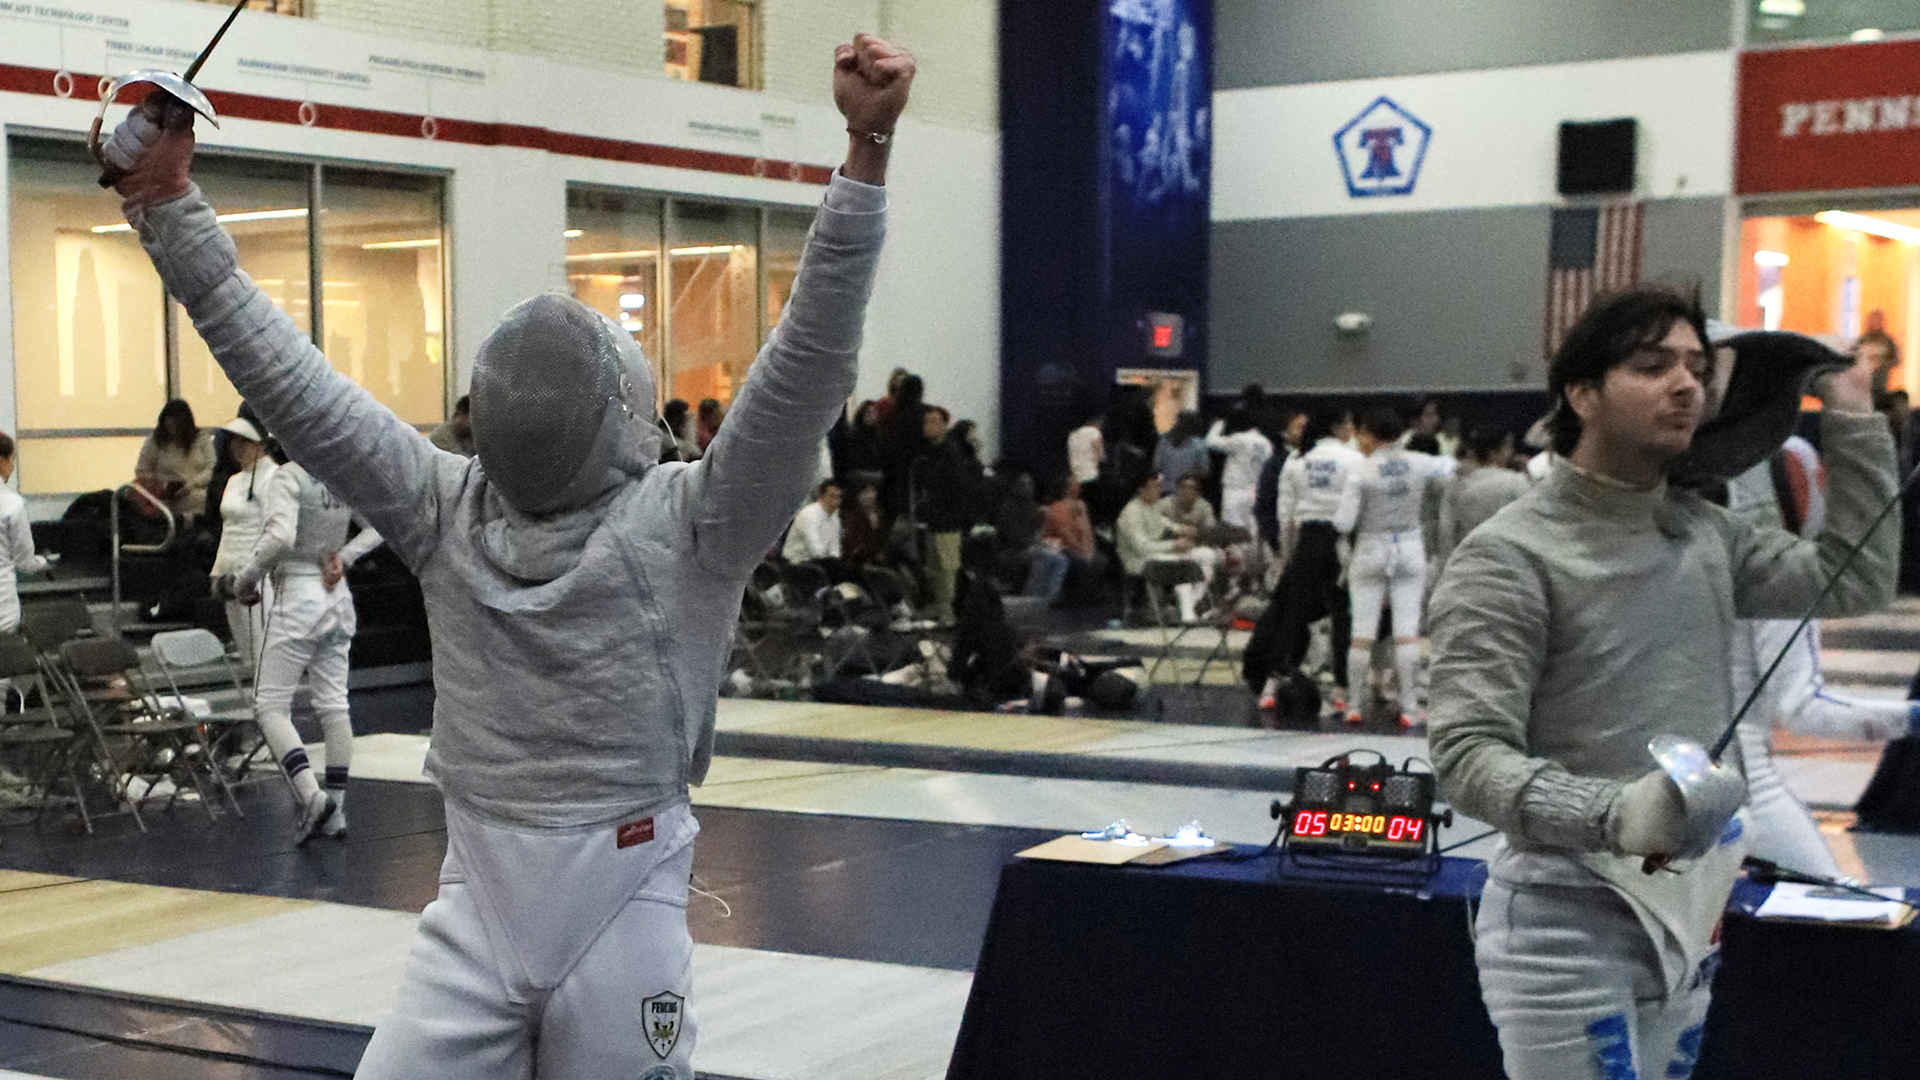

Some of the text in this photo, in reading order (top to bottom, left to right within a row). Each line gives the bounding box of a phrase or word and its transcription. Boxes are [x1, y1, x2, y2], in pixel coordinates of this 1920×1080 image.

[1780, 95, 1920, 137] PENN
[1293, 811, 1423, 841] 05 03:00 04
